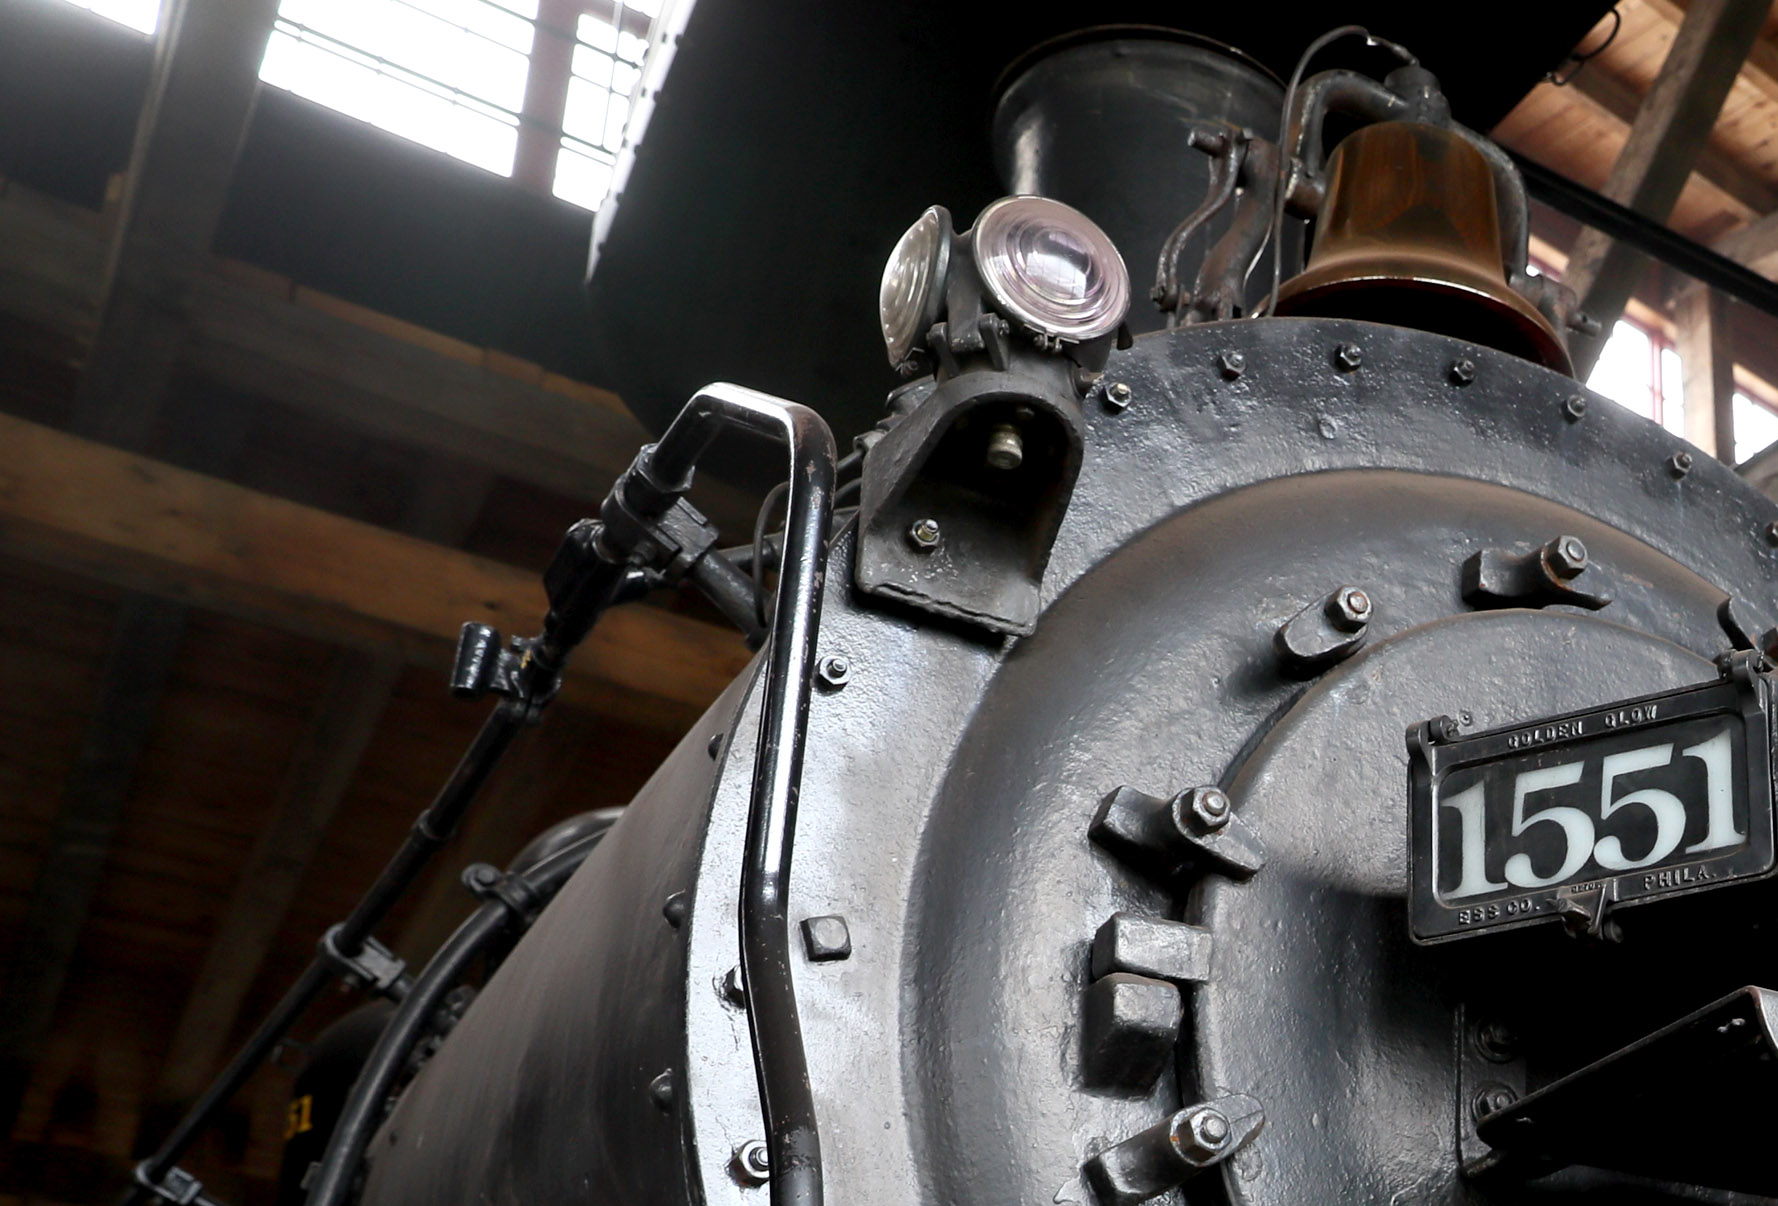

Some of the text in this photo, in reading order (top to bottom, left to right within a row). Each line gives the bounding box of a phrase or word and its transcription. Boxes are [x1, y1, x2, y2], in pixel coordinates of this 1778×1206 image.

[1508, 704, 1658, 748] GOLDEN GLOW
[1438, 728, 1749, 900] 1551
[1643, 864, 1717, 891] PHILA.
